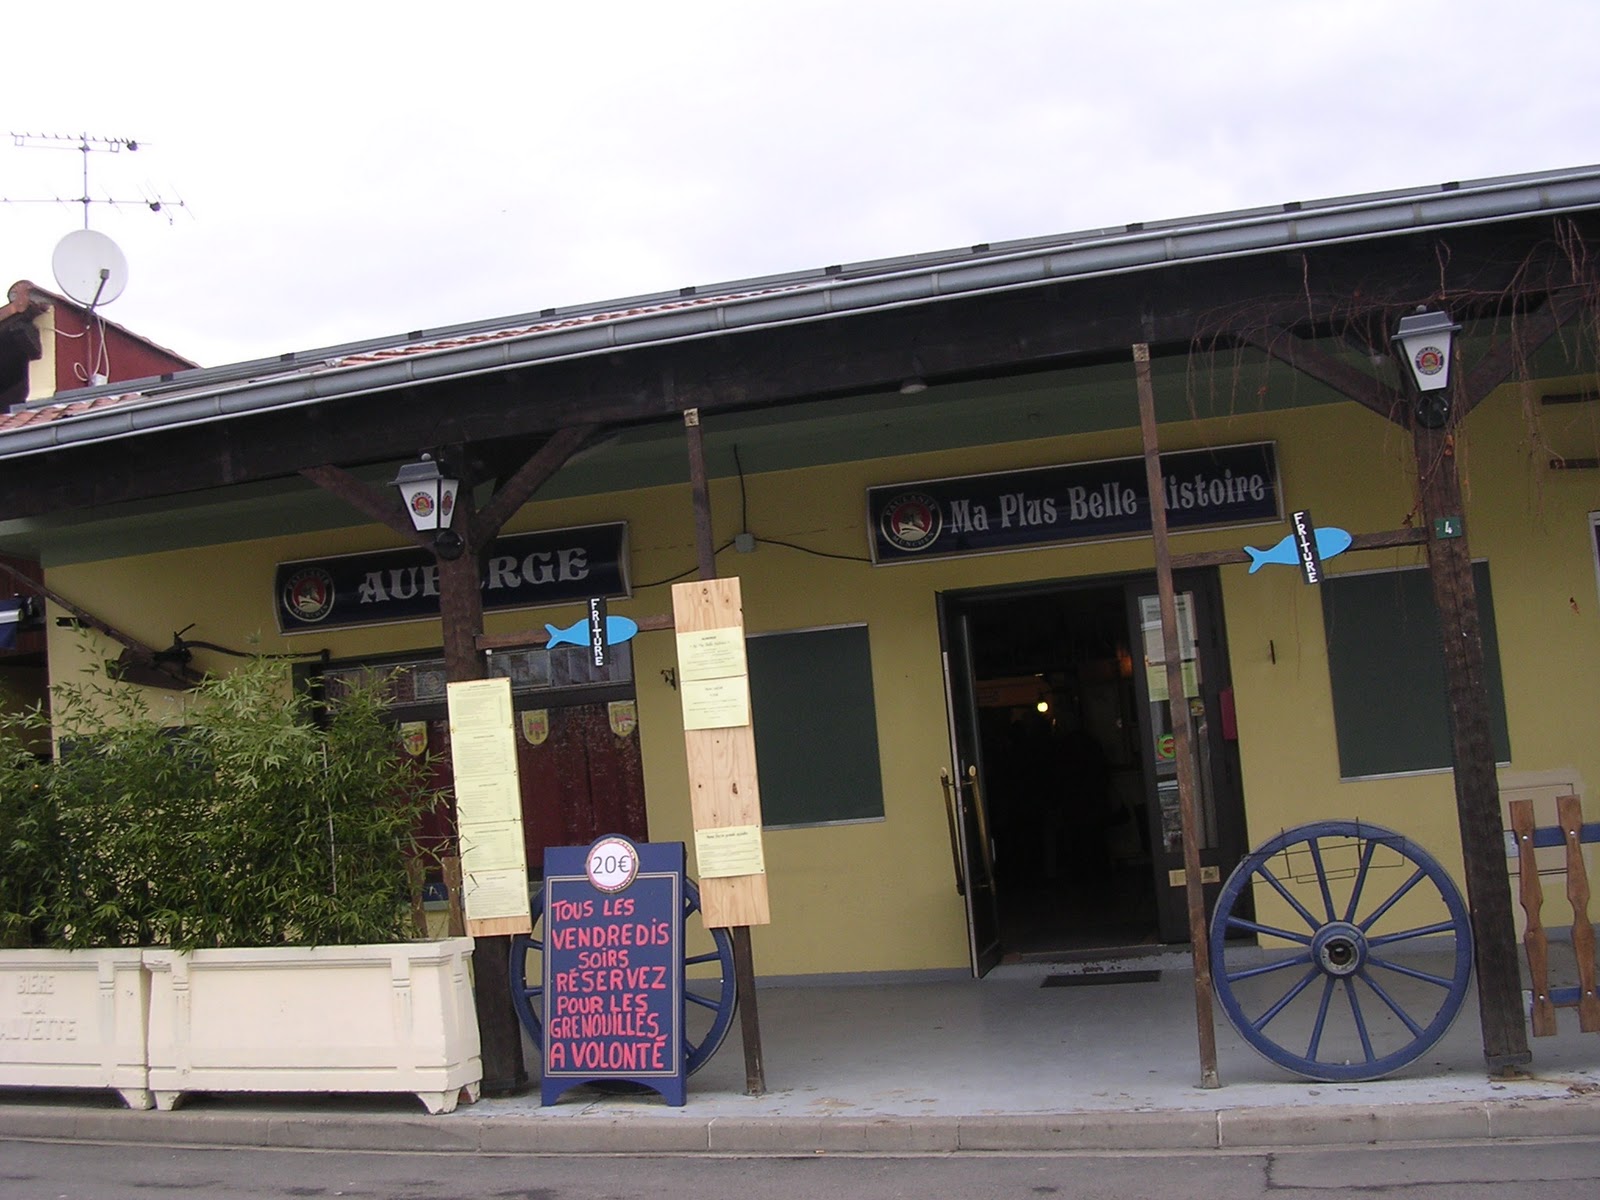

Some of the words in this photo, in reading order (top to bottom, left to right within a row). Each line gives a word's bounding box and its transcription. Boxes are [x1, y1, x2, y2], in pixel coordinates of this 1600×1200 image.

[950, 499, 990, 534] Ma
[999, 492, 1057, 528] Plus
[1067, 482, 1138, 522] Belle
[1162, 468, 1265, 510] istoire
[1444, 521, 1454, 535] 4
[1293, 511, 1319, 584] FRITURE
[358, 548, 590, 604] AUBRGE
[590, 598, 604, 667] FRITURE
[592, 855, 631, 875] 20€
[552, 899, 594, 922] TOUS
[603, 898, 635, 916] LES
[556, 966, 667, 993] RÉSERVEZ
[557, 995, 604, 1016] POUR
[610, 993, 649, 1015] LES
[550, 1012, 660, 1040] GRENOUILLES
[550, 1042, 566, 1069] A
[572, 1033, 669, 1070] VOLONTÉ
